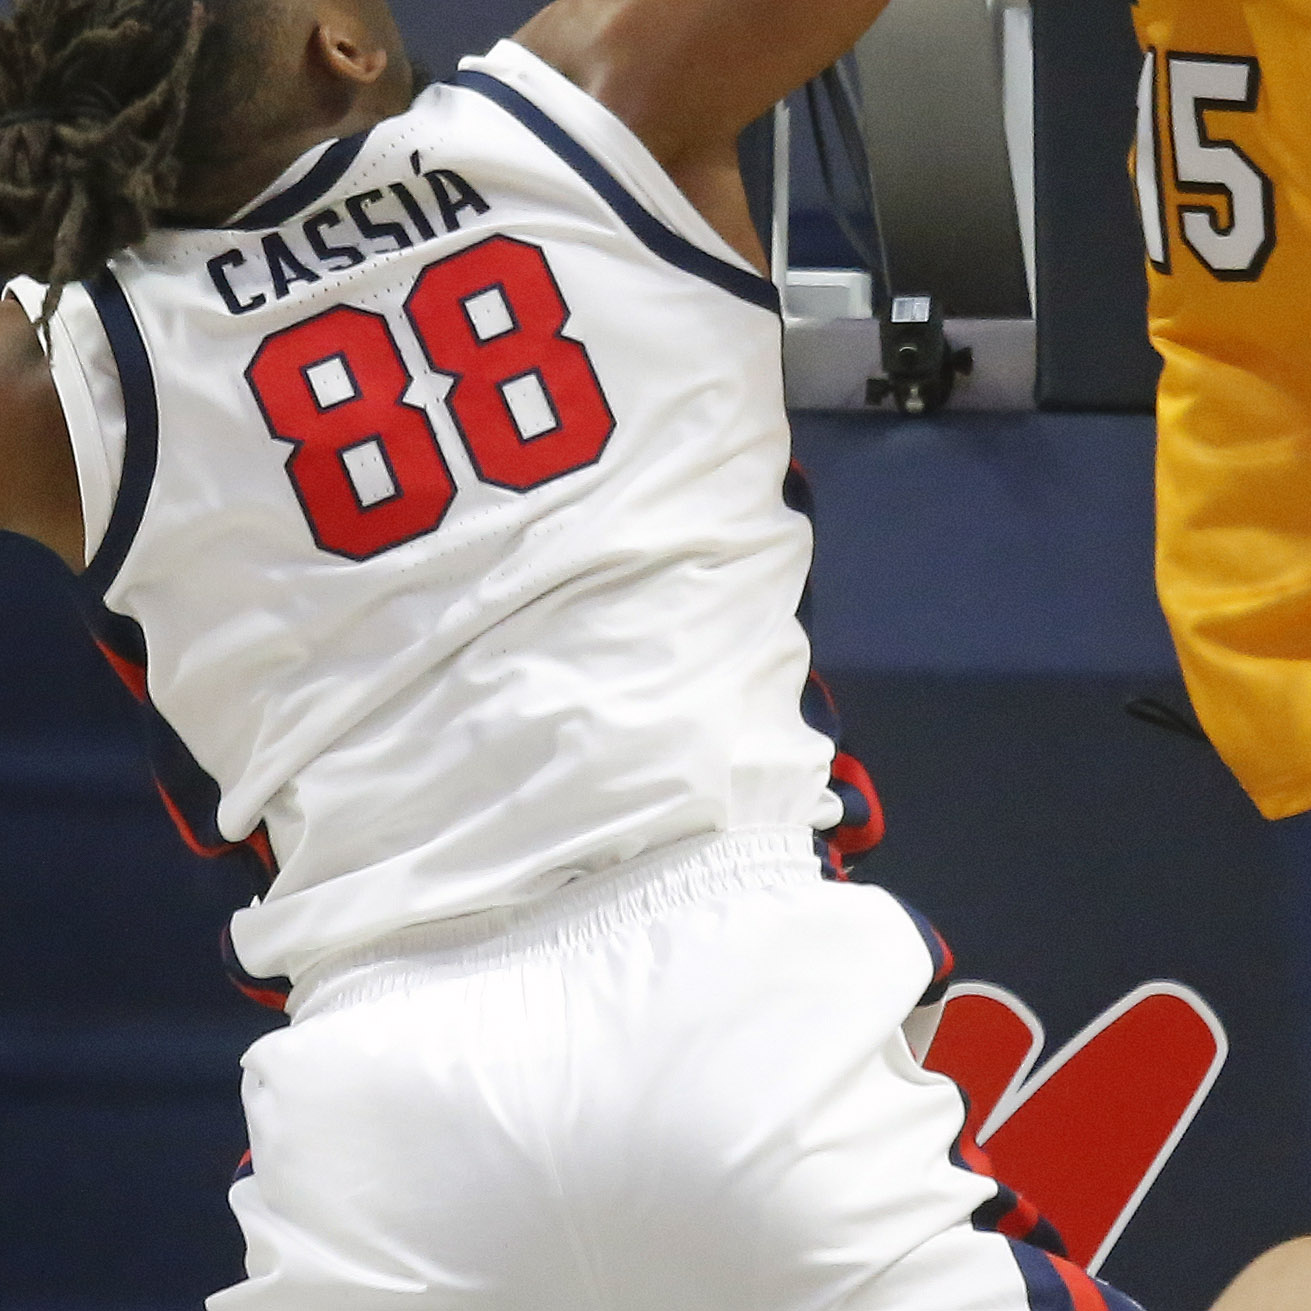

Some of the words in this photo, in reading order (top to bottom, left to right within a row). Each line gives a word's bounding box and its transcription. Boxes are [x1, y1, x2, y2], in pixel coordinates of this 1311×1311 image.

[206, 149, 490, 315] CASSÍA
[1135, 46, 1277, 283] 15
[244, 233, 617, 562] 88
